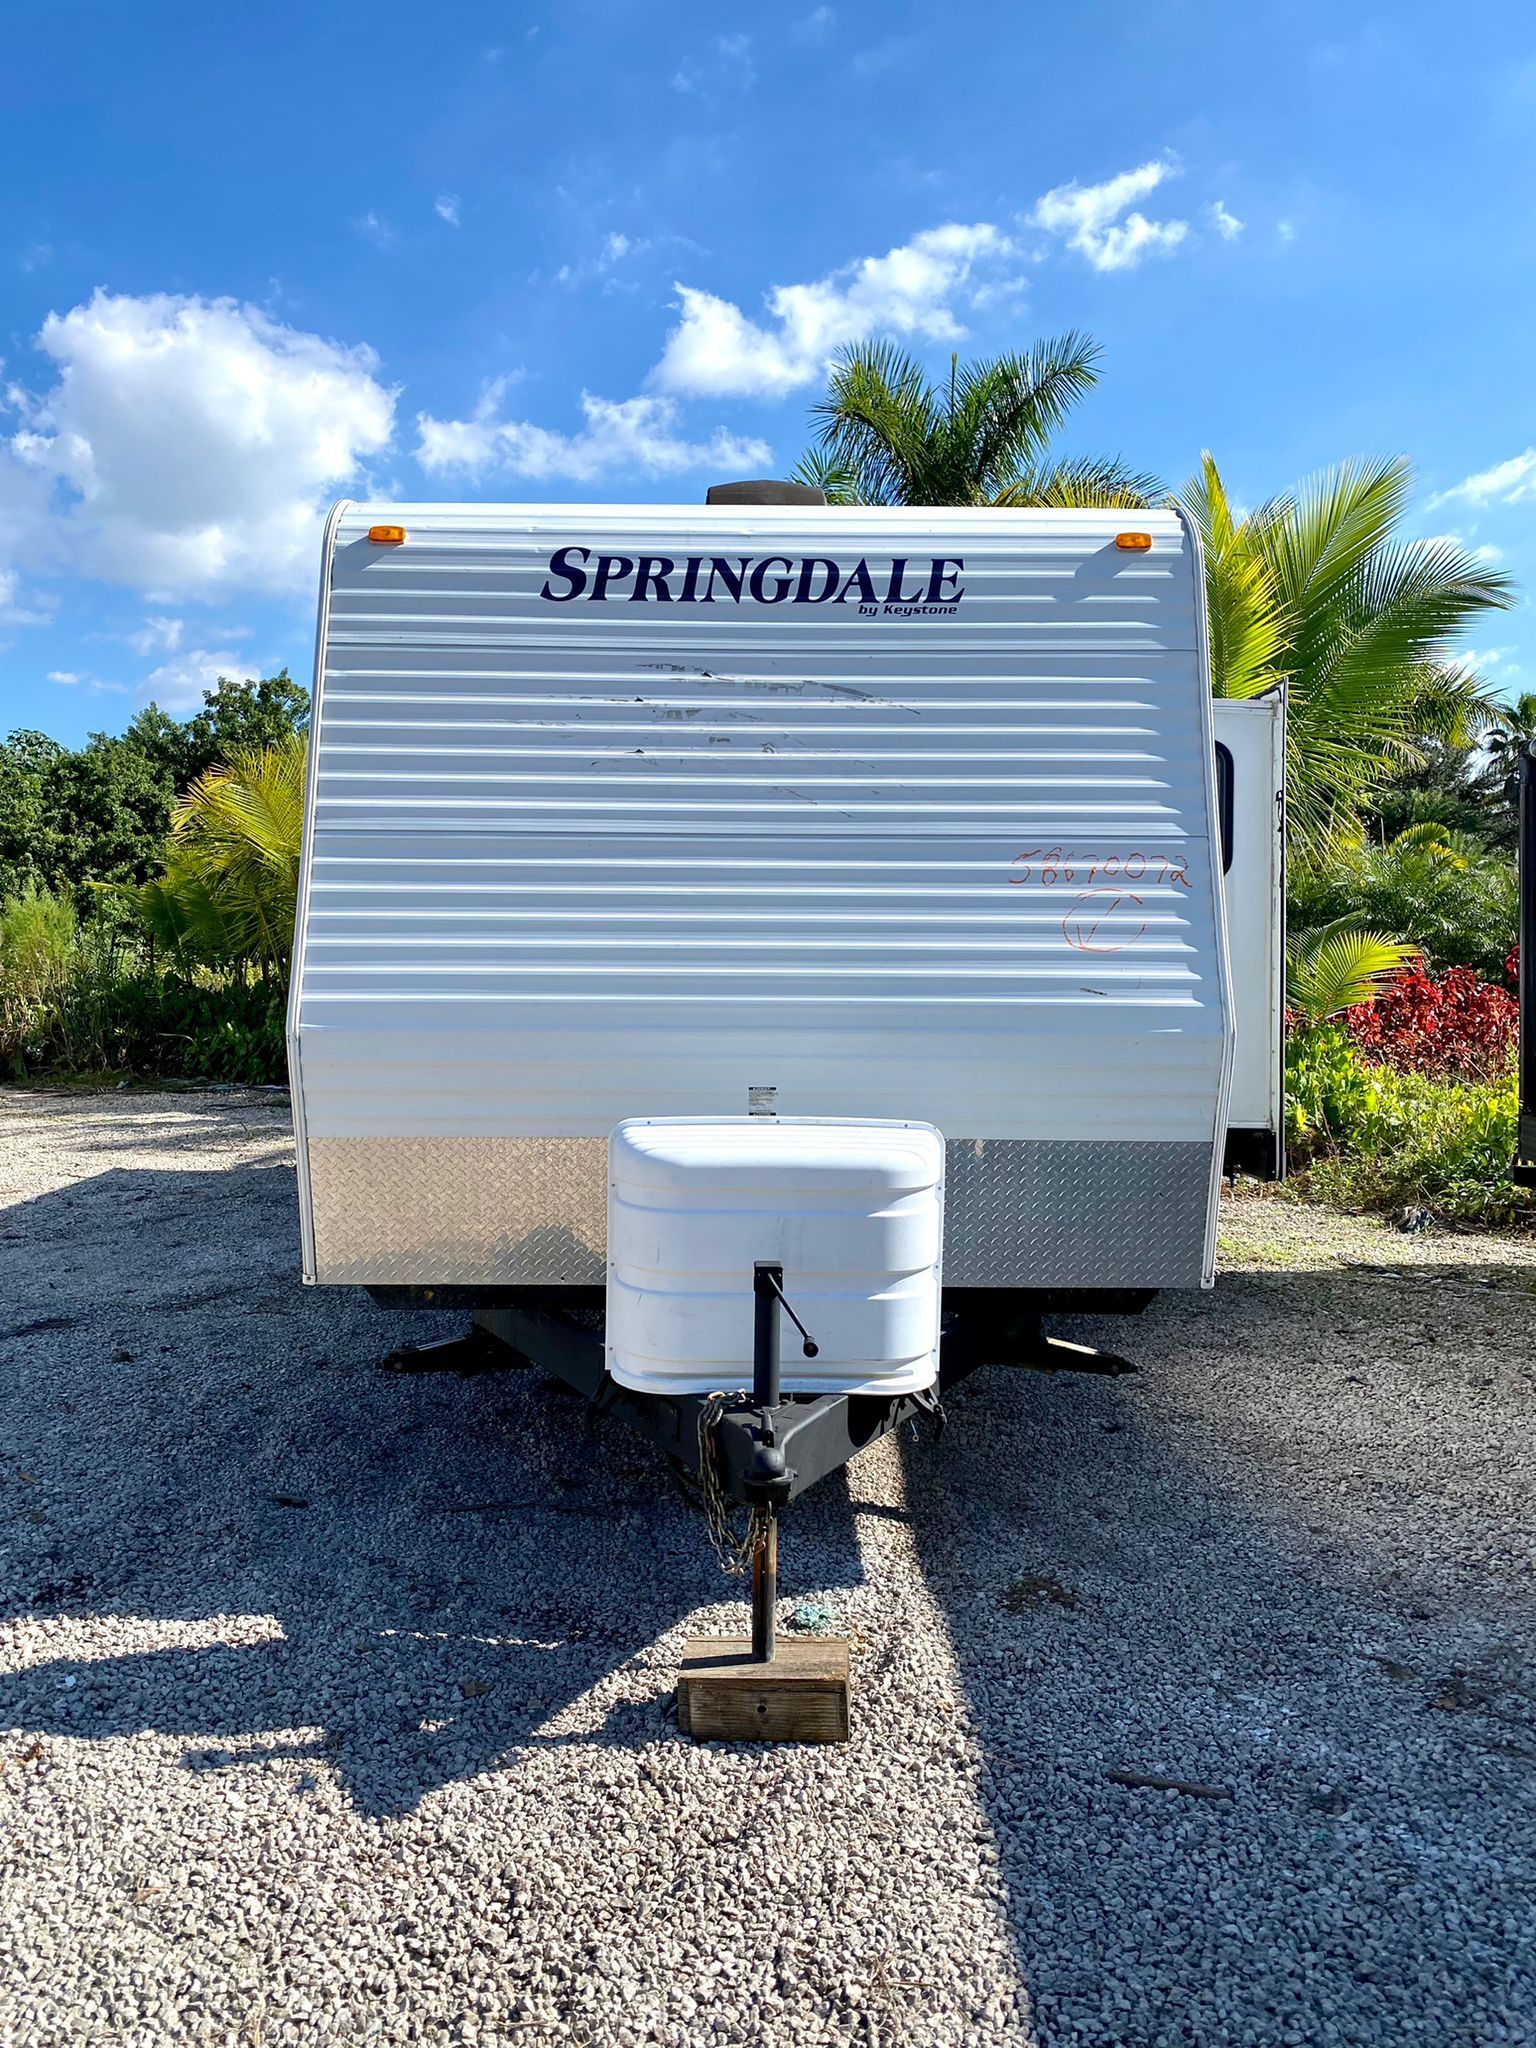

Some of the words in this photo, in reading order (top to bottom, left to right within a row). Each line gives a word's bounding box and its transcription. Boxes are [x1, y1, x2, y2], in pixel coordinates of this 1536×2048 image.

[540, 546, 966, 604] SPRINGDALE
[858, 605, 878, 617] by
[883, 604, 958, 617] Keystone
